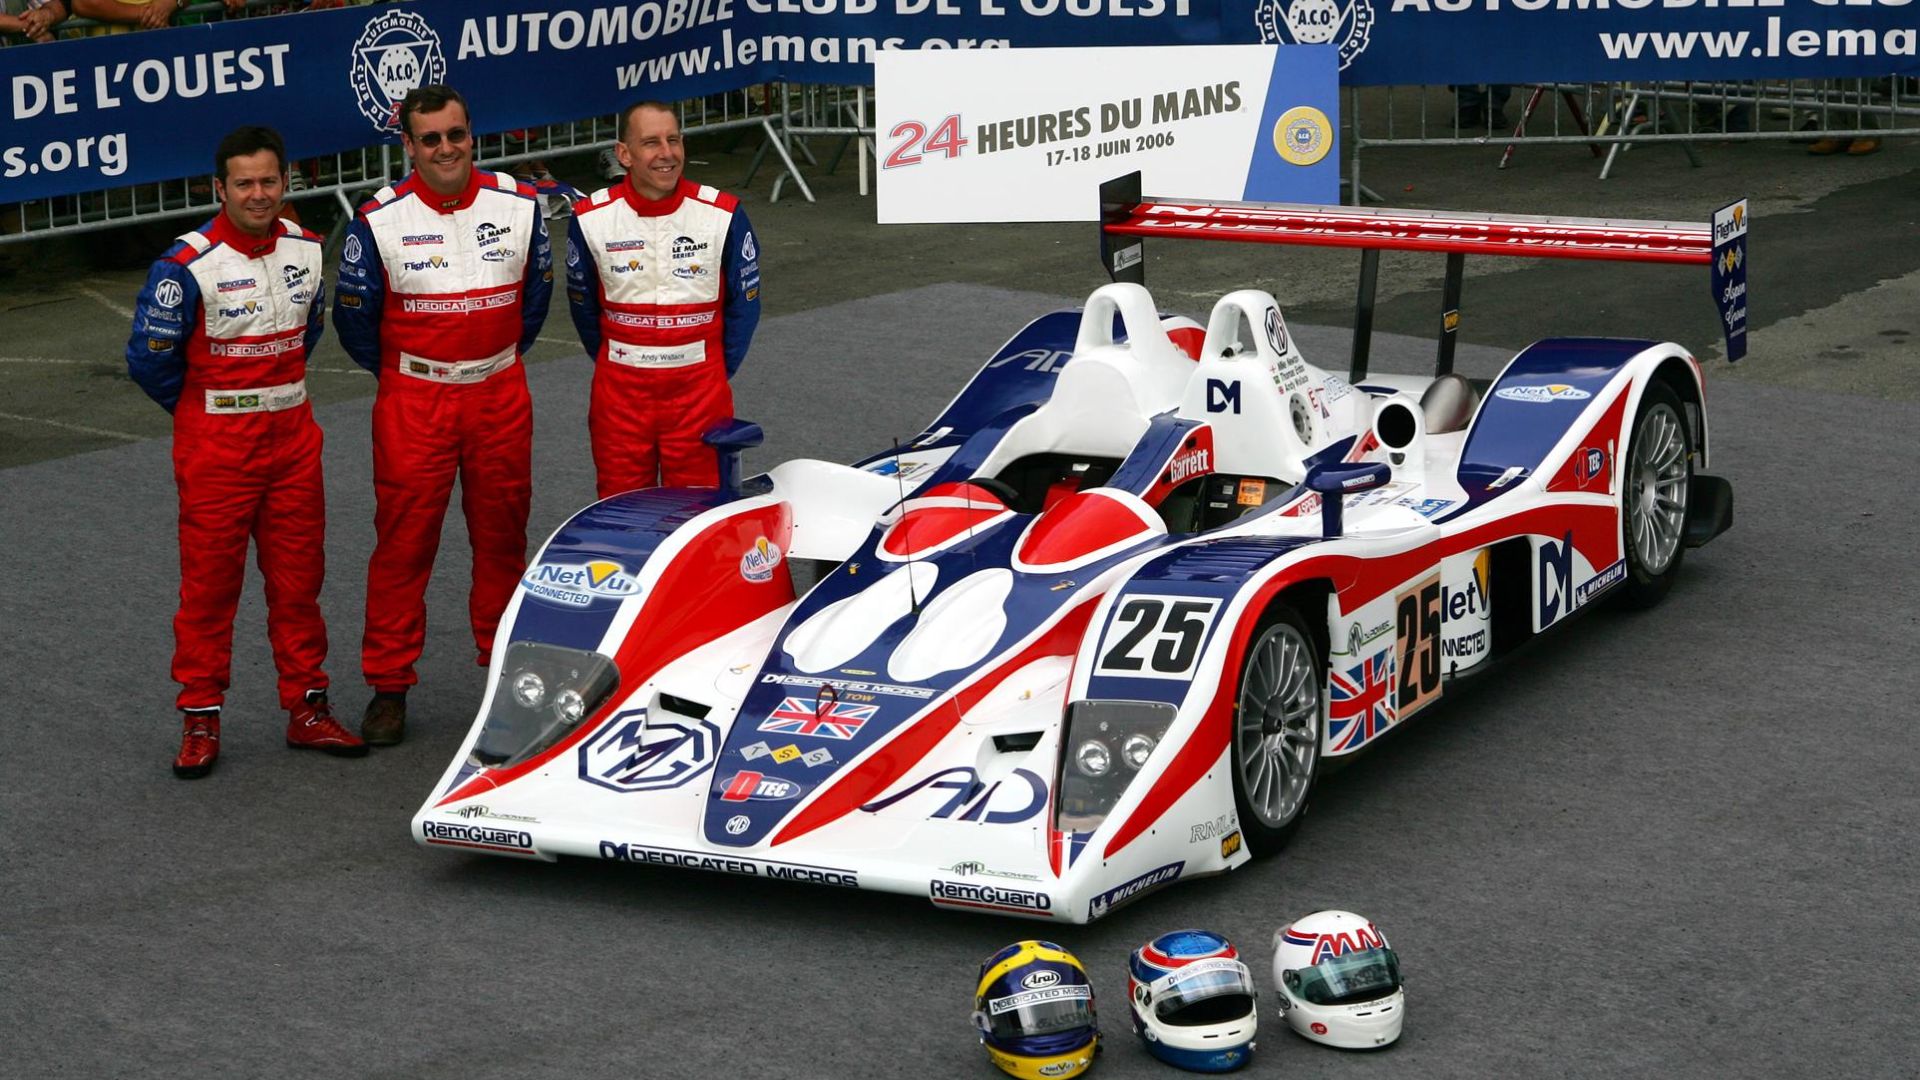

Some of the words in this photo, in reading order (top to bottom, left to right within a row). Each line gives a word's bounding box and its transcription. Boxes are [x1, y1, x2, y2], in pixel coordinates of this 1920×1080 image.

[365, 18, 427, 46] AUTOMOBILE
[1263, 5, 1275, 40] CLUB
[12, 70, 78, 120] DE
[94, 44, 290, 109] L'OUEST
[357, 65, 370, 101] CLUB
[370, 105, 385, 121] DE
[882, 113, 968, 170] 24
[977, 107, 1091, 154] HEURES
[1101, 98, 1142, 133] DU
[1152, 81, 1242, 124] MANS
[3, 133, 128, 178] s.org
[1046, 146, 1091, 167] 17-18
[1095, 138, 1130, 159] JUIN
[1136, 132, 1175, 152] 2006
[488, 226, 511, 237] MANS
[684, 243, 708, 251] MANS
[156, 281, 182, 306] MG
[417, 300, 482, 311] DEDICATED
[1207, 378, 1241, 414] DM
[1171, 449, 1209, 483] Garrett
[539, 561, 625, 591] NetVu
[1540, 530, 1573, 630] DM
[1587, 563, 1625, 595] MICHELIN
[533, 584, 590, 605] CONNECTED
[1101, 599, 1214, 673] 25
[1397, 581, 1441, 709] 25
[785, 676, 868, 691] DEDICATED
[871, 684, 934, 697] MICROS
[845, 693, 876, 702] TOW
[590, 714, 711, 788] MG
[727, 816, 749, 834] MG
[1221, 831, 1241, 858] OMP
[631, 850, 758, 876] DEDICATED
[766, 864, 859, 888] MICROS
[1110, 866, 1178, 904] MICHELIN
[1027, 973, 1056, 985] Arai
[1001, 990, 1060, 1009] DEDICATED
